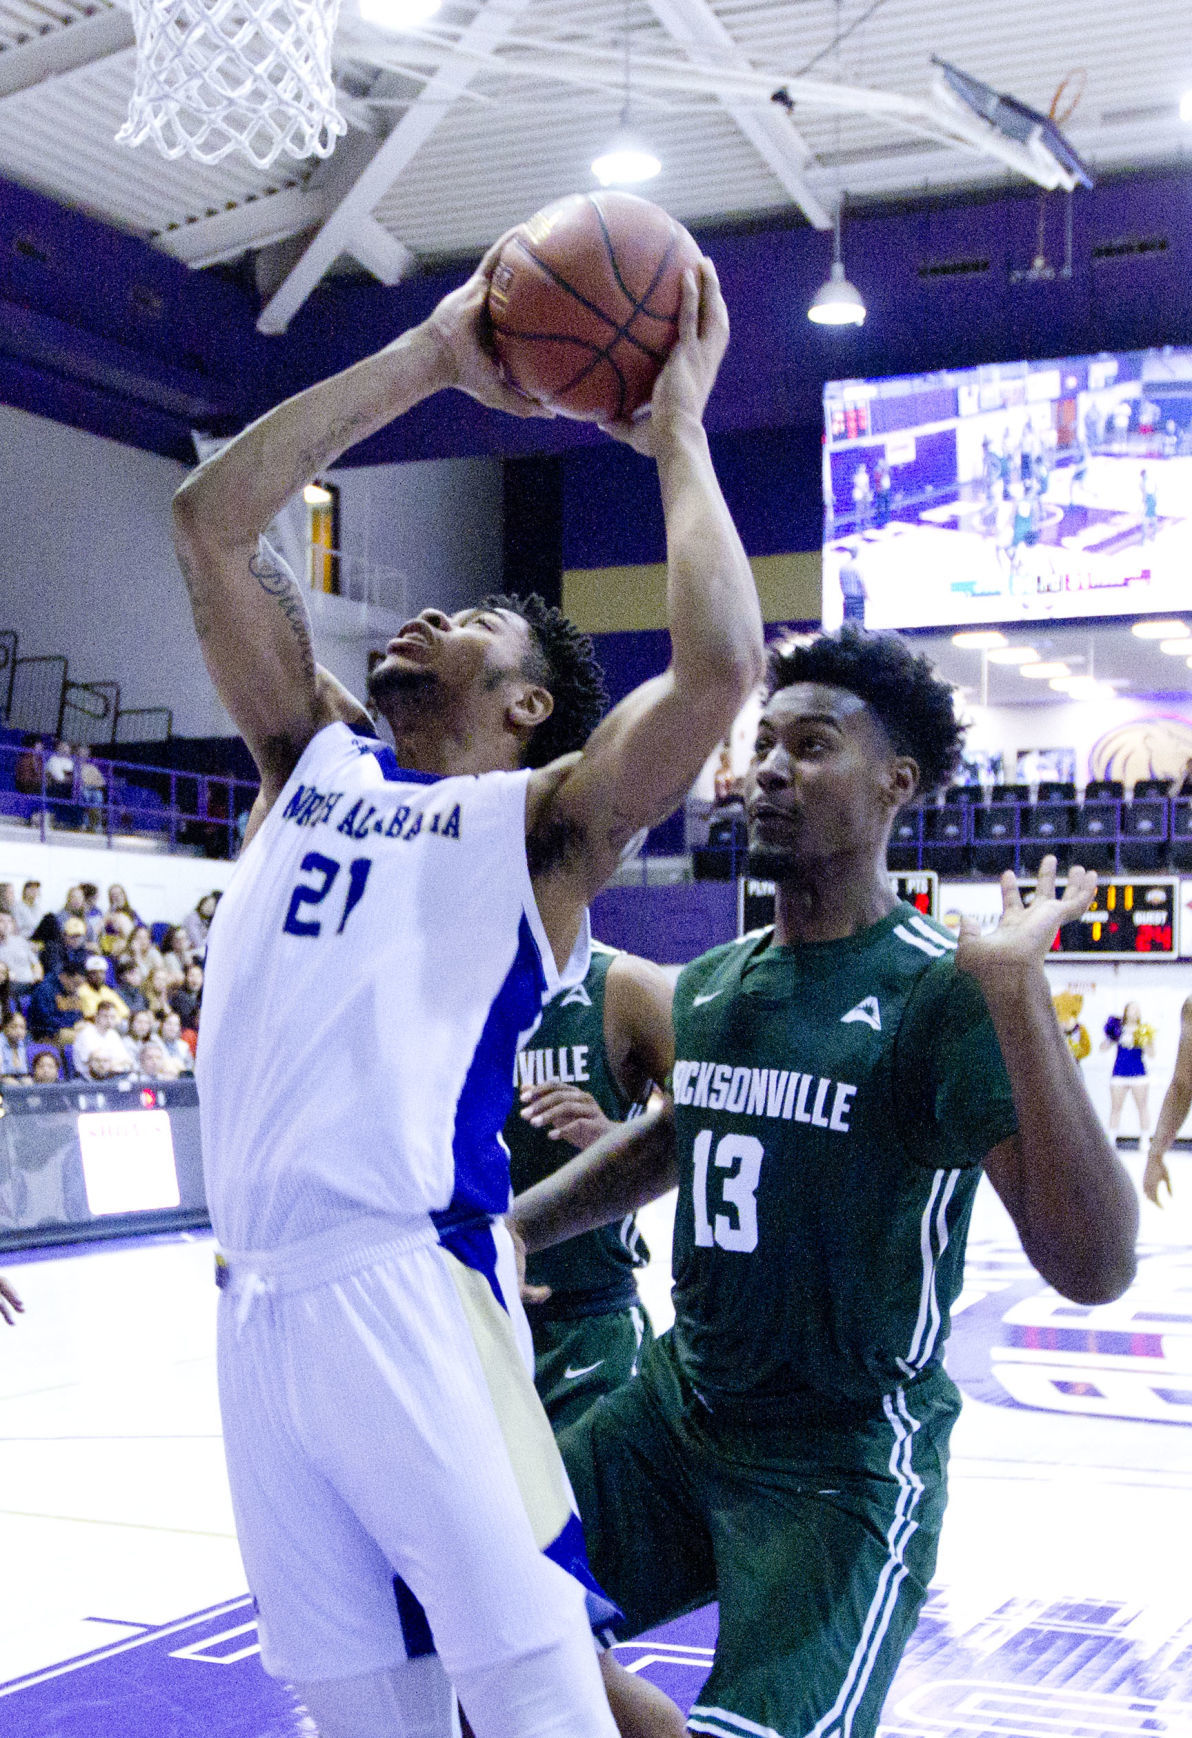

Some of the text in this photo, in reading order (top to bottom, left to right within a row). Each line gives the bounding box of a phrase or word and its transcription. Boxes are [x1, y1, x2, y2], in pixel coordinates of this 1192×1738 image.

[337, 799, 461, 840] ALBAA
[282, 851, 372, 938] 21
[692, 1129, 764, 1253] 13
